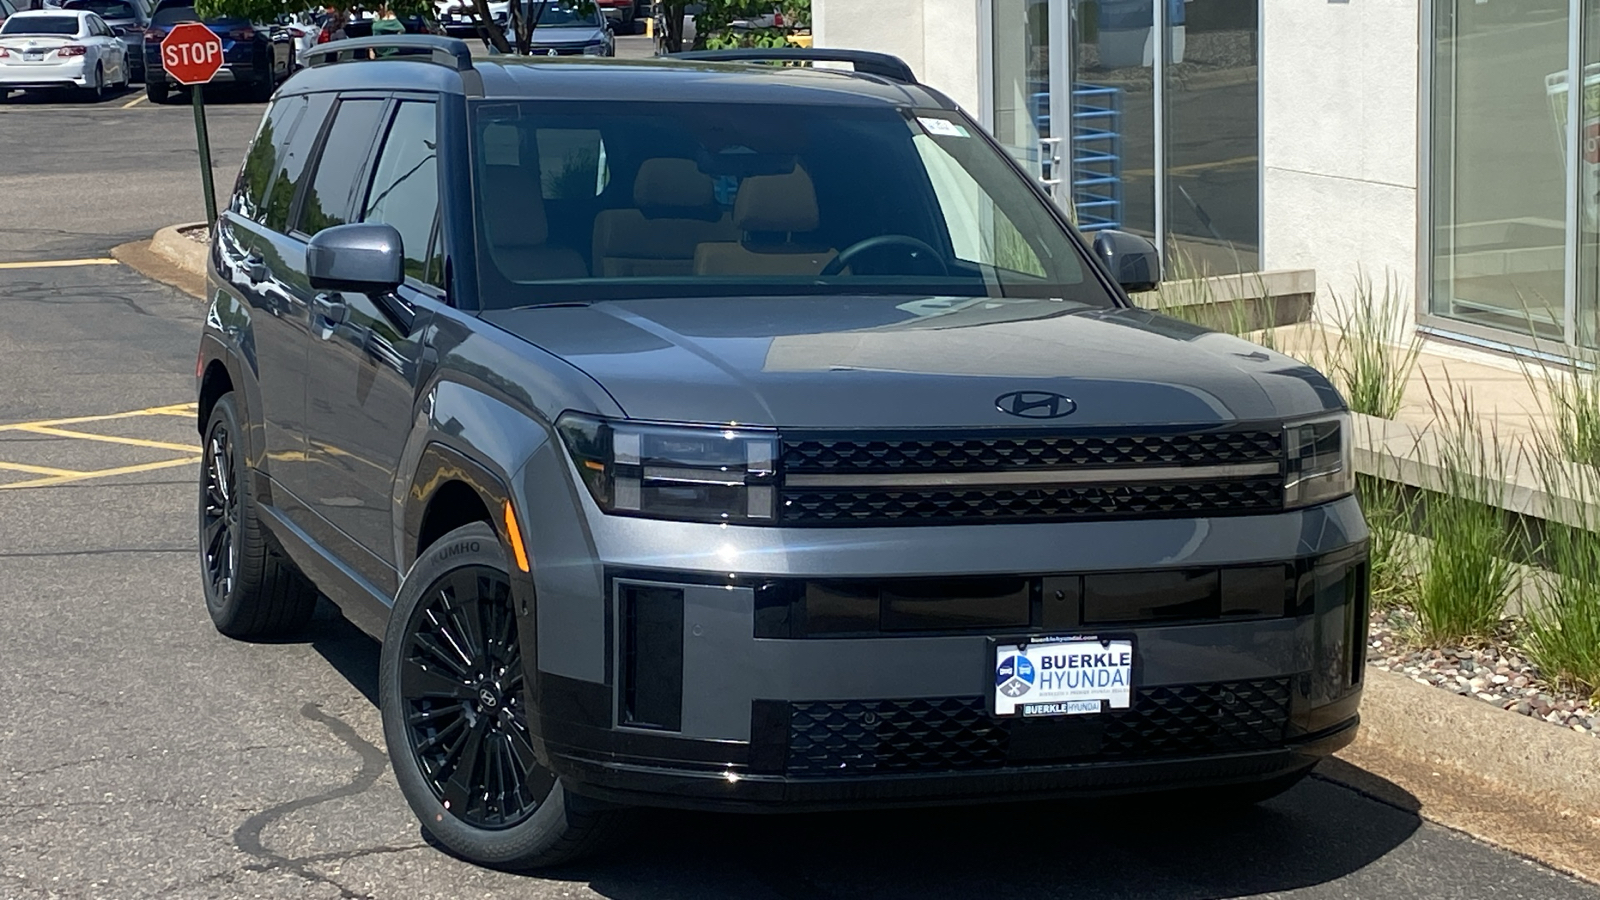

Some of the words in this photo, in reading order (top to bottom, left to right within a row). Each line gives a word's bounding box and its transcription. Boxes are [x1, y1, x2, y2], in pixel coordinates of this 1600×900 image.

[166, 41, 219, 67] STOP
[430, 541, 480, 567] KUMHO
[1041, 652, 1130, 669] BUERKLE
[1040, 668, 1131, 689] HYUNDAI
[1025, 703, 1067, 715] BUERKLE
[1068, 702, 1099, 712] HYUNDAI
